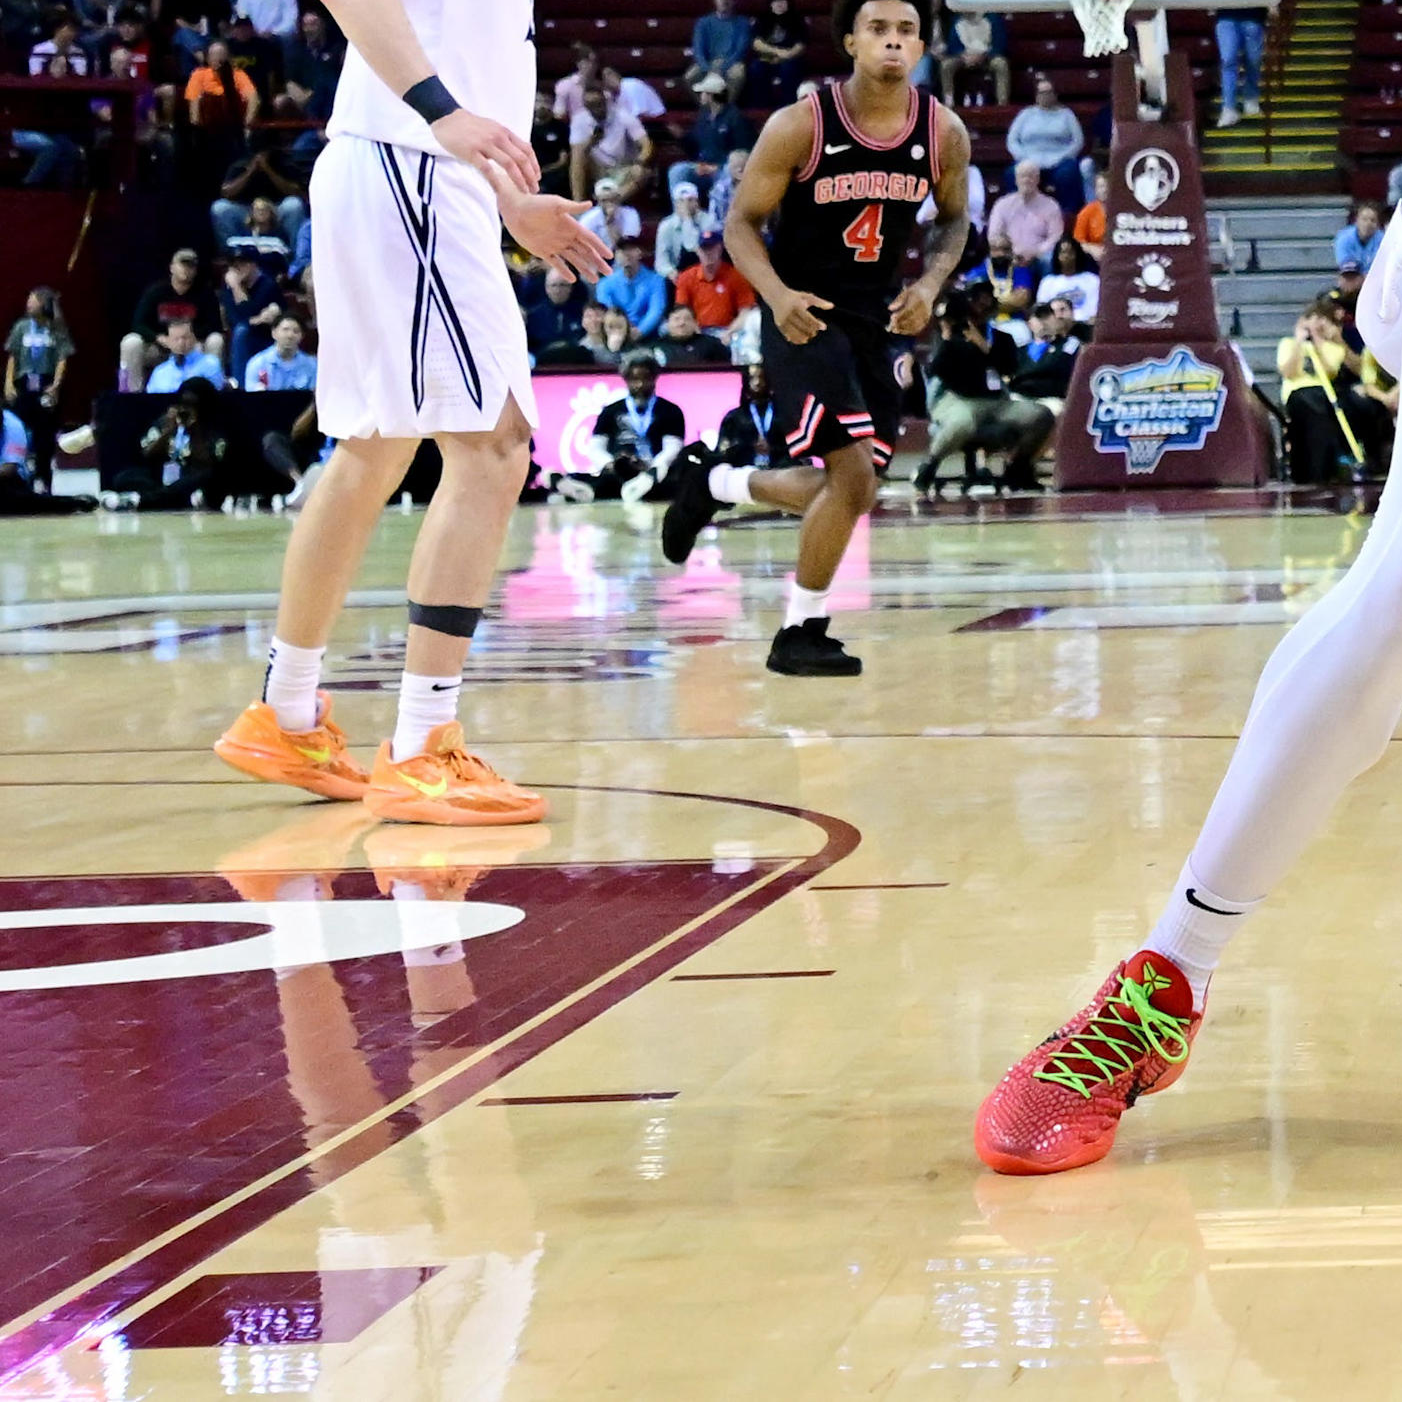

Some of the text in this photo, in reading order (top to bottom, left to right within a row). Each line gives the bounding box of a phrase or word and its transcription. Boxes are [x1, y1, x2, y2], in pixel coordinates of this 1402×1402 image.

[814, 170, 929, 205] GEORGIA
[1116, 212, 1188, 231] Shriners
[843, 204, 883, 263] 4
[1113, 230, 1193, 245] Children's
[1097, 399, 1216, 422] Charleston
[1114, 419, 1188, 438] Classic
